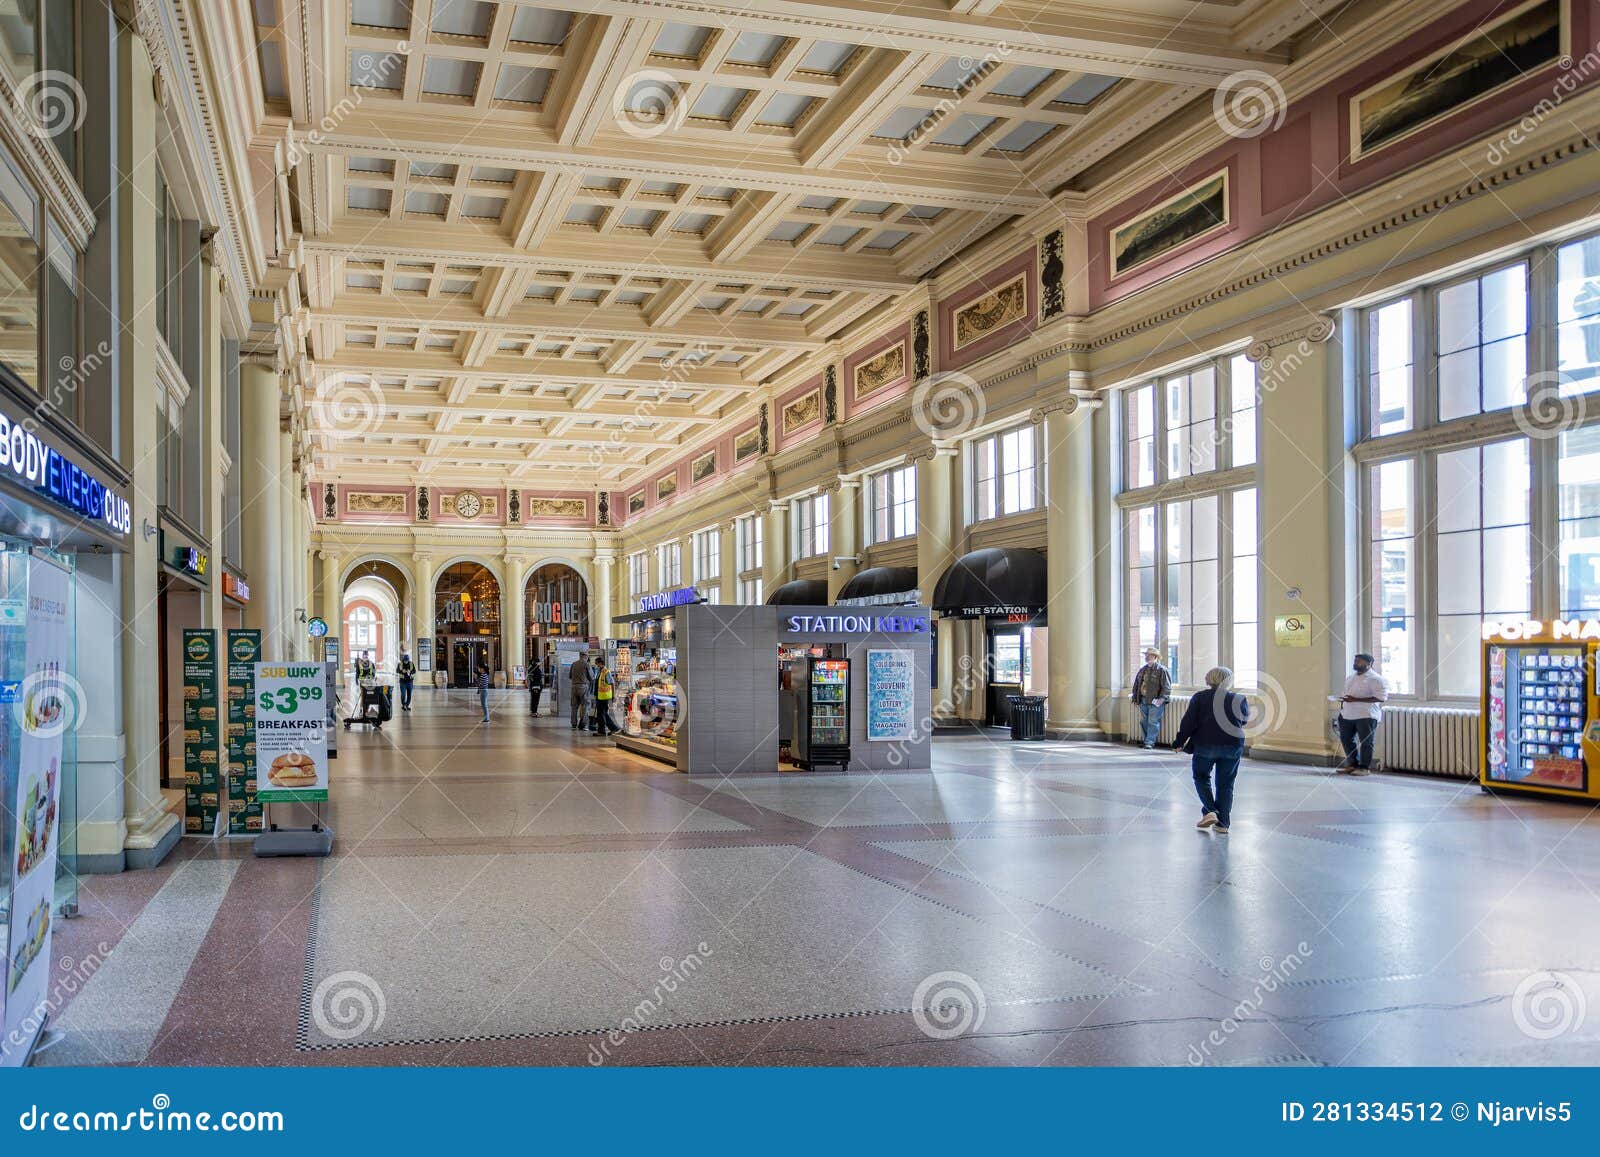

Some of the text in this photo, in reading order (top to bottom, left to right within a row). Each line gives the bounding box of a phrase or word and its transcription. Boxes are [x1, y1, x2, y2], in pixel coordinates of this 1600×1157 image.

[640, 586, 695, 612] STATION NEWS
[535, 602, 579, 623] ROGUE
[962, 606, 1028, 615] THE STATION
[1007, 614, 1029, 623] EXIT
[789, 615, 928, 633] STATION NEWS
[1482, 619, 1543, 640] POP
[260, 667, 320, 678] SUBWAY
[876, 682, 906, 690] SOUVENIR
[879, 700, 902, 708] LOTTERY
[258, 720, 325, 729] BREAKFAST
